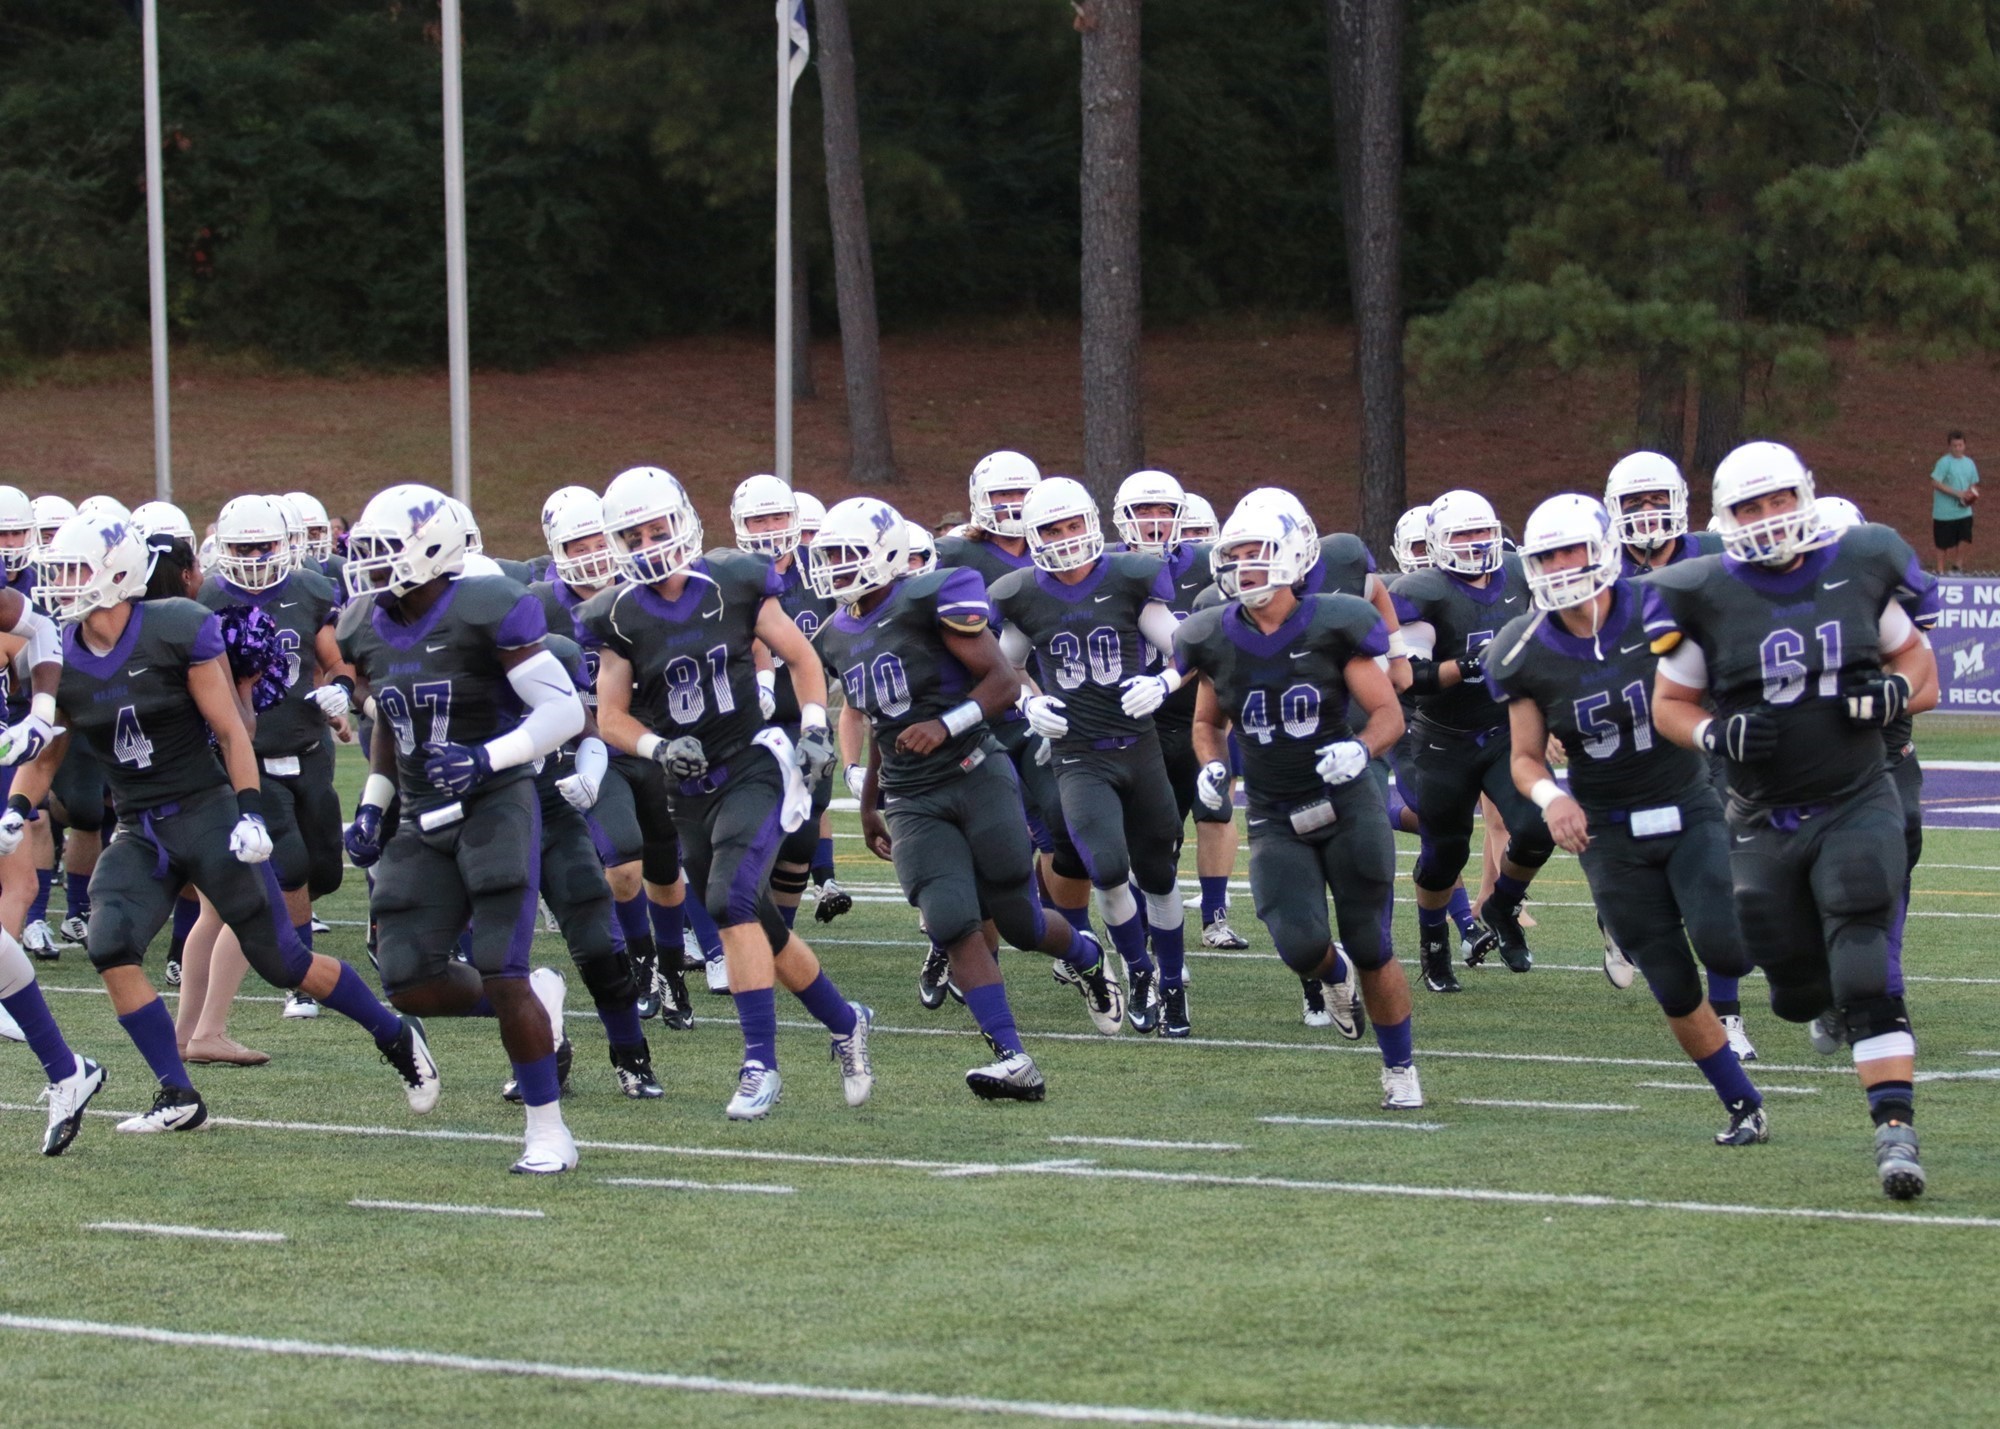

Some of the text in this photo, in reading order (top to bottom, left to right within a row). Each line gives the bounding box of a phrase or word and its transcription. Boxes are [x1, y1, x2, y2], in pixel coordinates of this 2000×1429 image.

[1935, 609, 2000, 629] IFINA
[664, 644, 736, 725] 81
[843, 652, 911, 719] 70
[1050, 626, 1122, 689] 30
[1760, 621, 1842, 703] 61
[1953, 642, 1985, 680] M
[114, 705, 153, 769] 4
[379, 680, 451, 755] 97
[1241, 684, 1320, 744] 40
[1574, 680, 1652, 759] 51
